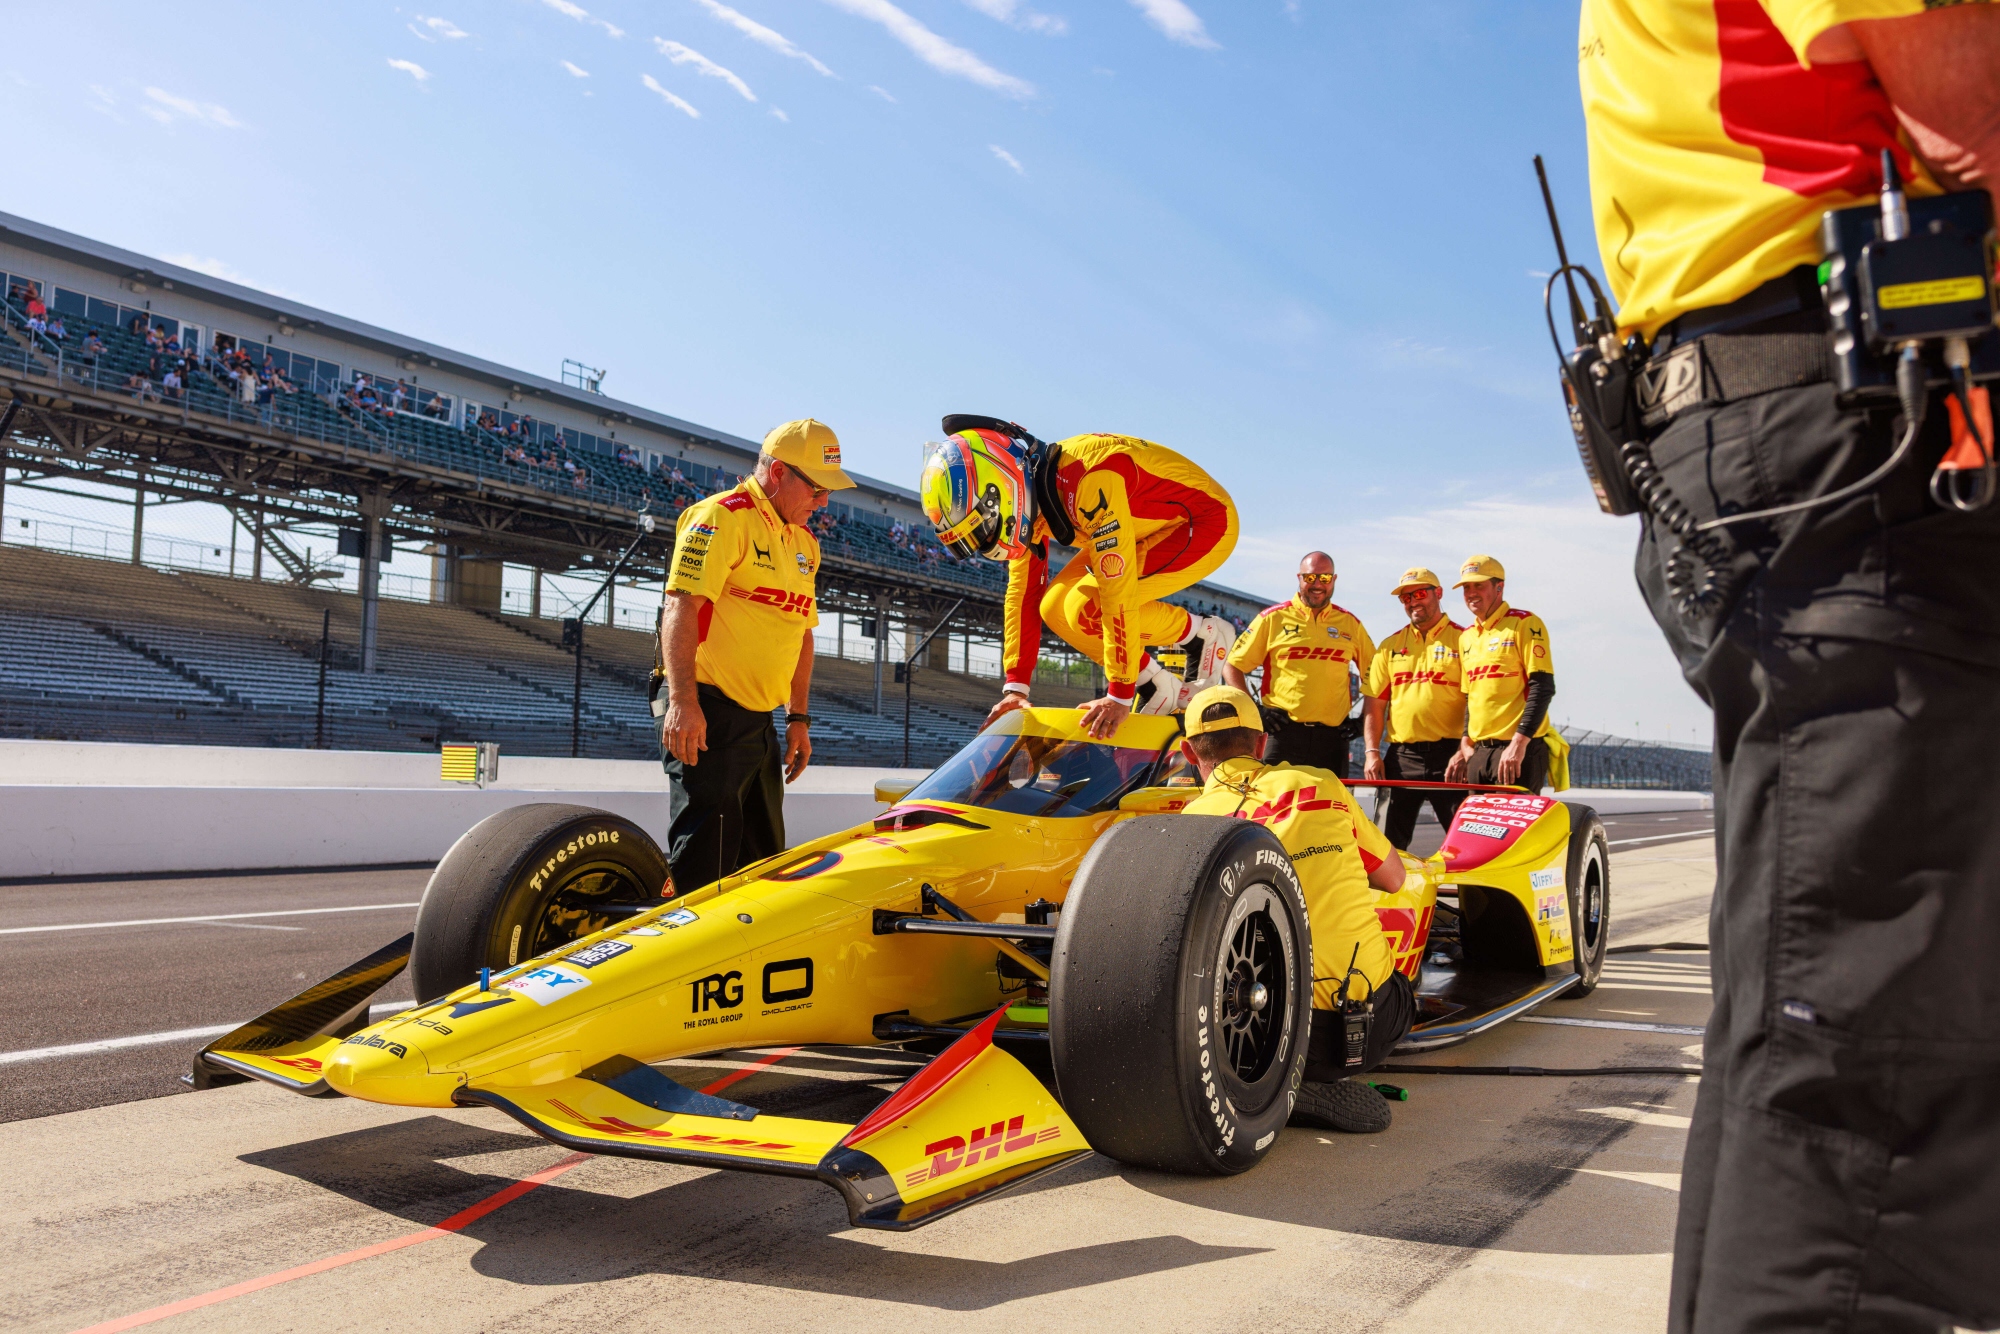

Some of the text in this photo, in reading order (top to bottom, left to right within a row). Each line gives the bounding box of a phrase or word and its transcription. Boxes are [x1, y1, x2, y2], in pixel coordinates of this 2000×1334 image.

[748, 586, 812, 618] DHL
[1112, 612, 1128, 665] DHL
[1287, 646, 1347, 663] DHL
[1393, 670, 1449, 687] DHL
[1459, 806, 1540, 821] SUNOCO
[1459, 813, 1528, 828] SOLO
[1493, 803, 1542, 812] insurance
[529, 830, 620, 892] Firestone
[1255, 849, 1310, 931] FIREHAWK
[1538, 893, 1565, 921] HRC
[686, 970, 744, 1014] TRG
[683, 1013, 744, 1030] THE ROYAL GROUP
[761, 1002, 814, 1017] OMOLOGATO
[1198, 1005, 1236, 1147] Firestone
[925, 1114, 1037, 1180] DHL
